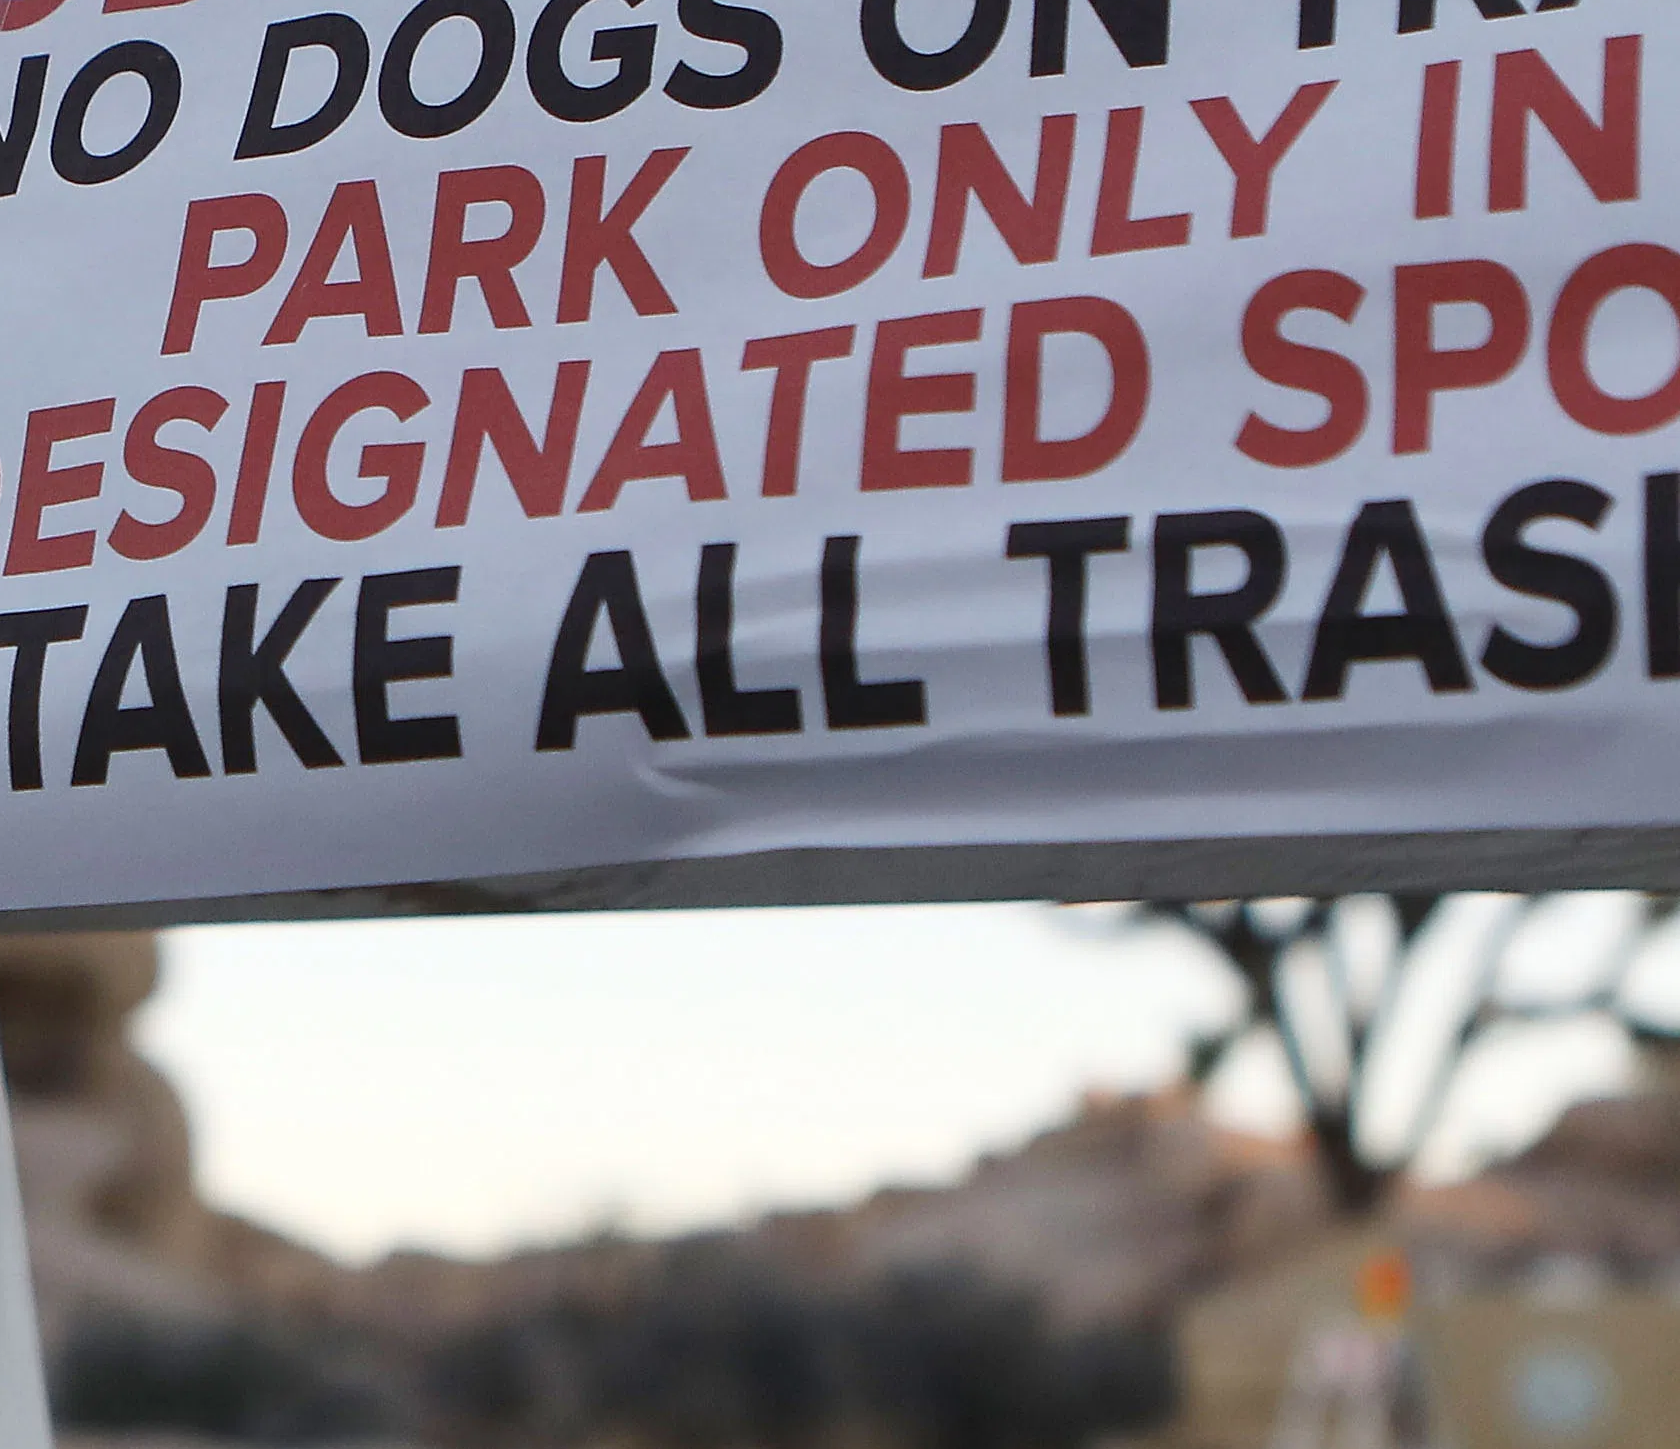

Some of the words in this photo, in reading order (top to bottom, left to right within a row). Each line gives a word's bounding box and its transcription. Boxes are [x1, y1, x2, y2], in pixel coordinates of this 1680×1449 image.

[162, 147, 689, 355] PARK
[760, 81, 1335, 299] ONLY
[1417, 36, 1640, 219] IN
[533, 535, 928, 753] ALL
